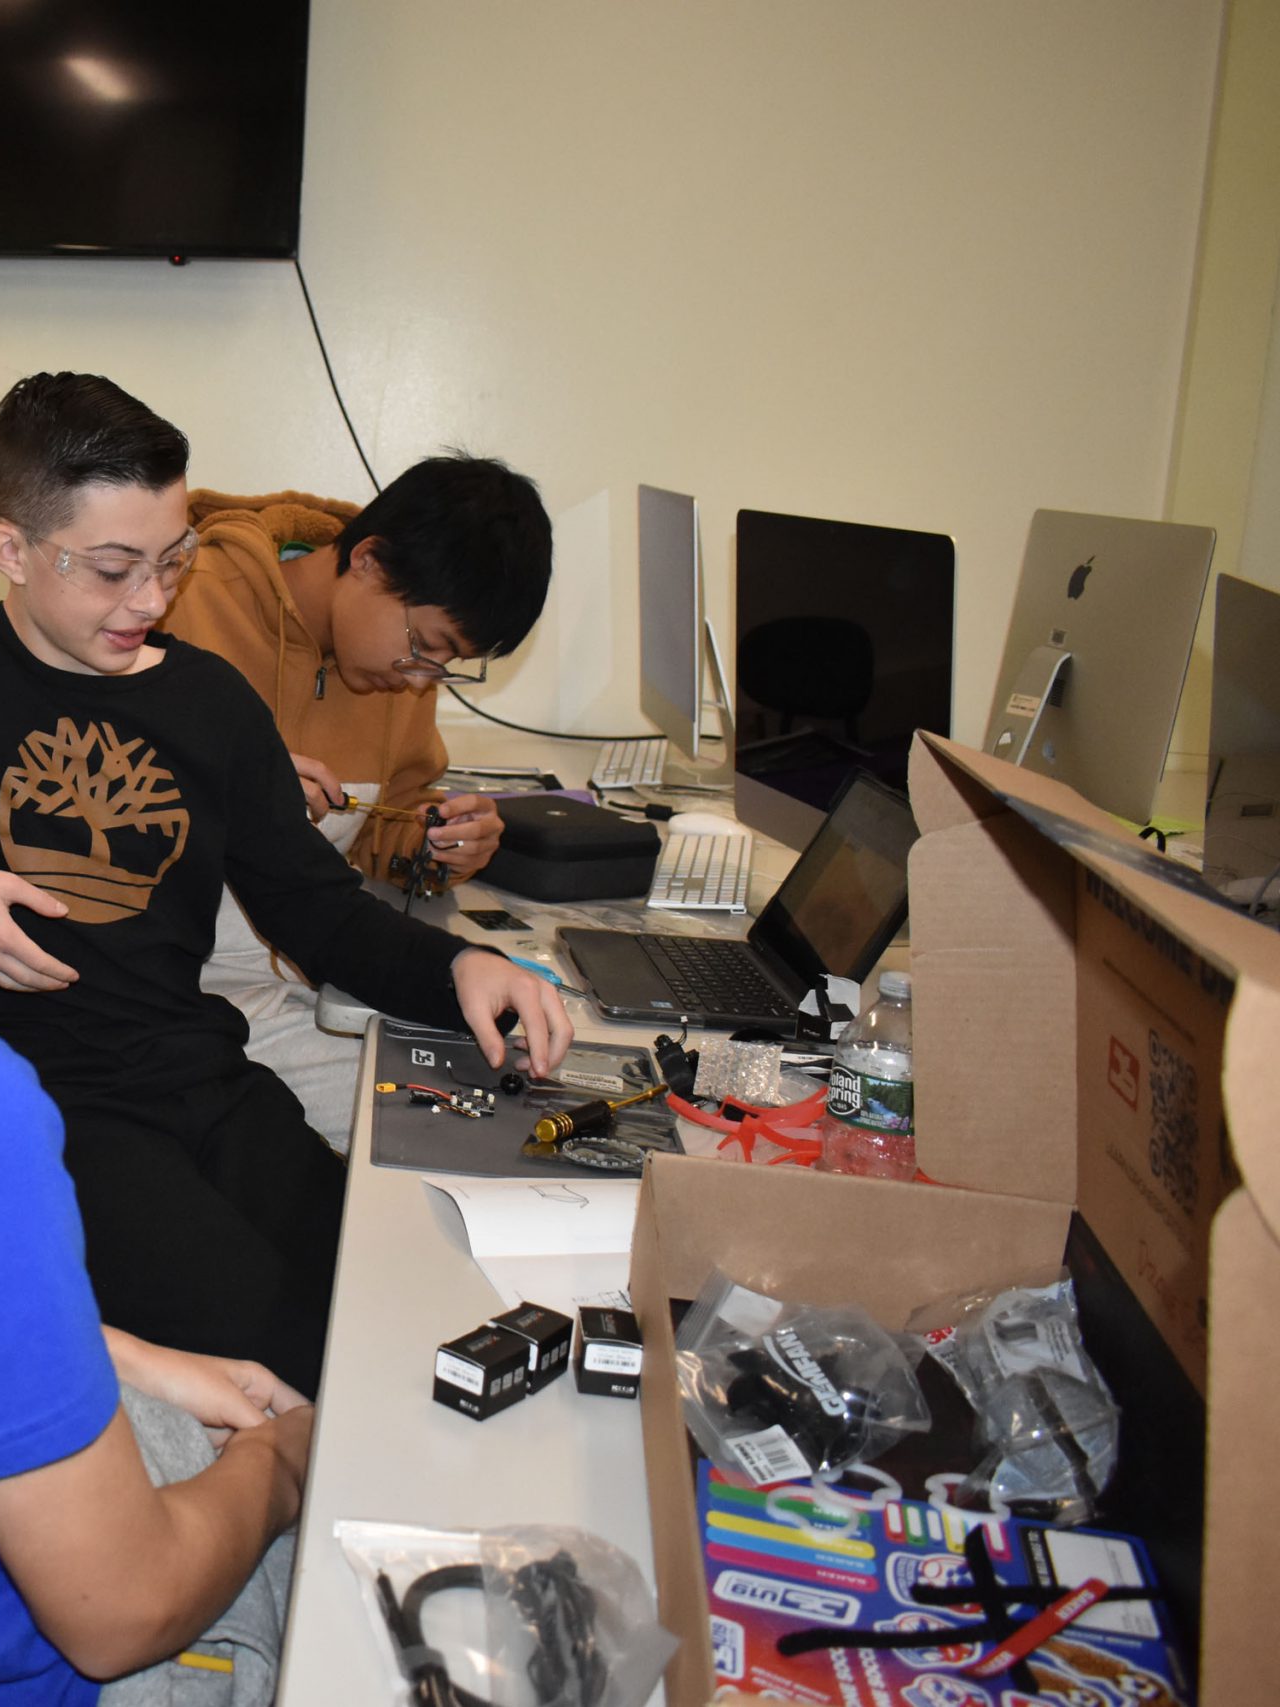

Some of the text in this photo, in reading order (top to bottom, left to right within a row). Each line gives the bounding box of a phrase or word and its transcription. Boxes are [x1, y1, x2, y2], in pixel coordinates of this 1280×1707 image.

[831, 1071, 861, 1093] oland
[829, 1086, 861, 1109] pring
[775, 1331, 848, 1417] GEMFAN
